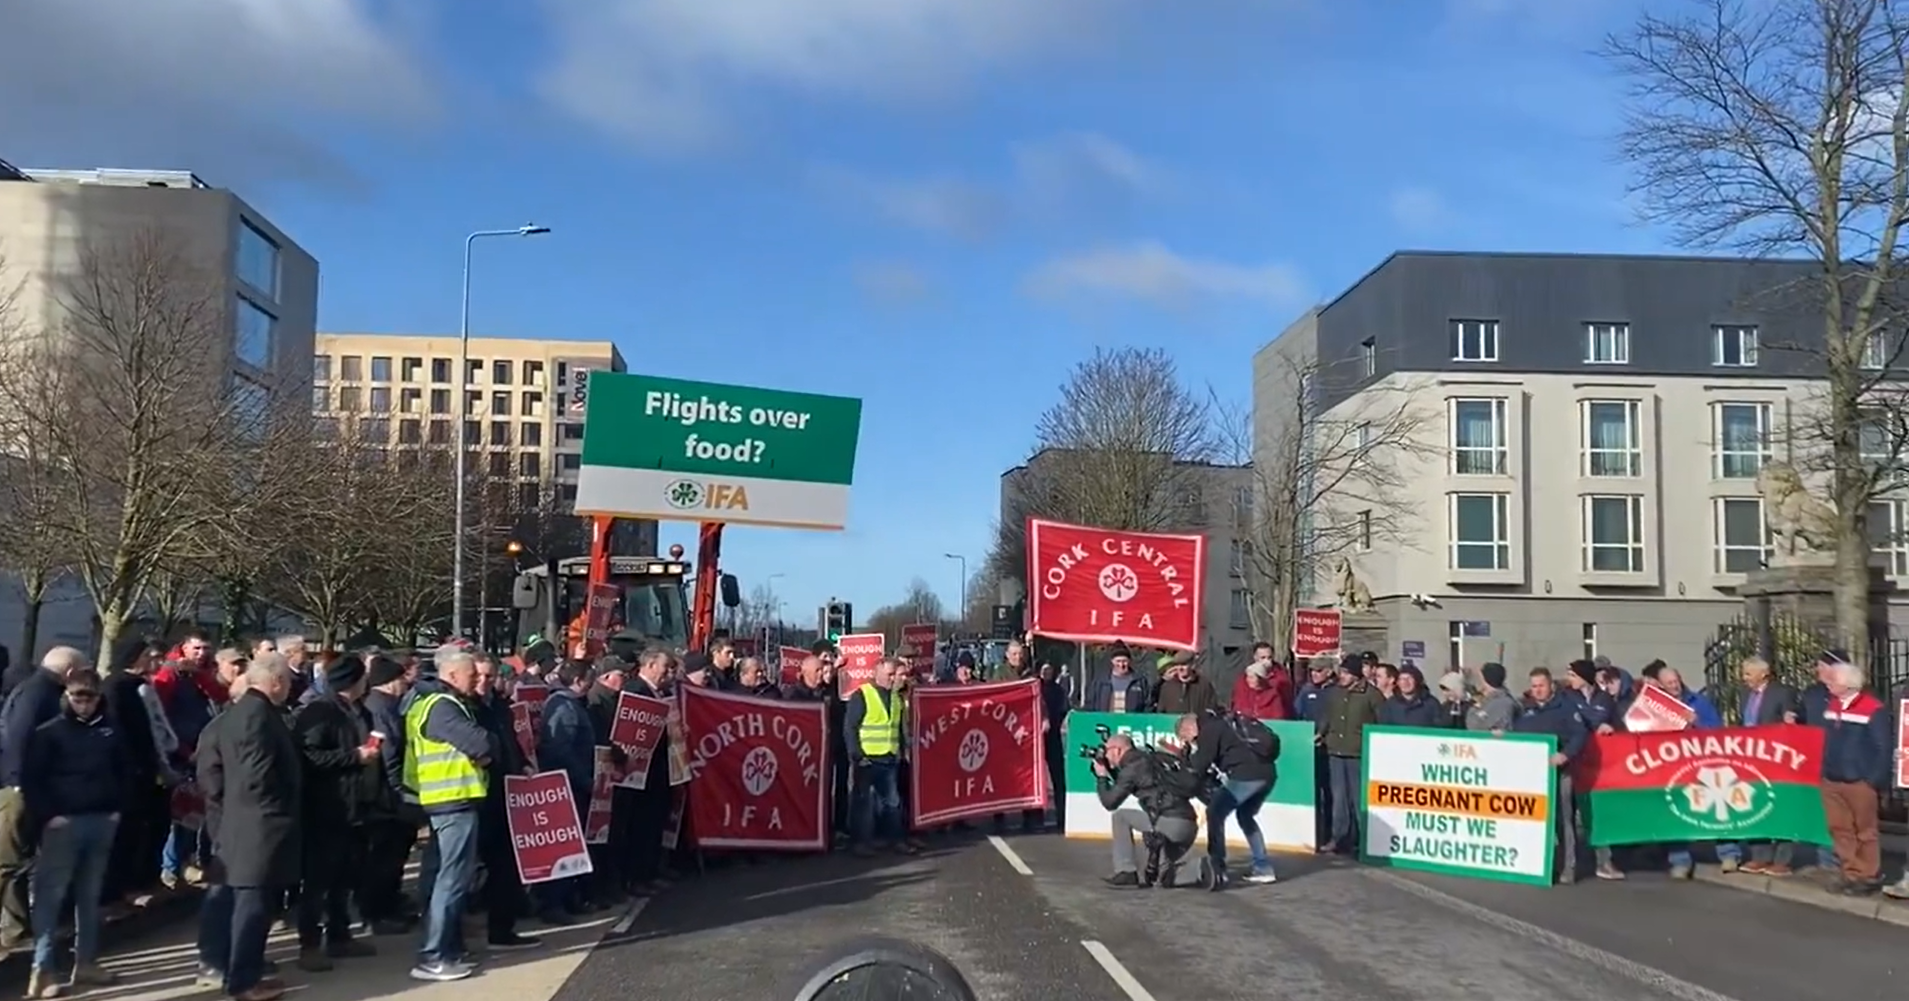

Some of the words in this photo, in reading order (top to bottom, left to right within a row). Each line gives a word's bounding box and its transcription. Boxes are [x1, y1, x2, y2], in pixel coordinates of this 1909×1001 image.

[645, 391, 742, 425] Flights
[750, 408, 811, 430] over
[685, 434, 766, 463] food?
[705, 484, 748, 510] IFA
[1043, 542, 1089, 600] CORK
[1102, 538, 1189, 609] CENTRAL
[1298, 616, 1339, 626] ENOUGH
[841, 643, 882, 655] ENOUGH
[856, 657, 867, 666] IS
[635, 729, 647, 741] IS
[920, 701, 972, 750] WEST
[980, 699, 1029, 746] CORK
[689, 713, 765, 778] NORTH
[773, 715, 818, 787] CORK
[1117, 725, 1182, 752] Fairn
[1454, 744, 1477, 759] IFA
[1625, 736, 1807, 776] CLONAKILTY
[1421, 764, 1488, 786] WHICH
[509, 786, 568, 807] ENOUGH
[1377, 785, 1483, 811] PREGNANT
[1490, 794, 1536, 816] COW
[532, 811, 549, 826] IS
[1405, 811, 1460, 834] MUST
[1468, 818, 1497, 838] WE
[516, 825, 579, 849] ENOUGH
[1390, 835, 1518, 867] SLAUGHTER?
